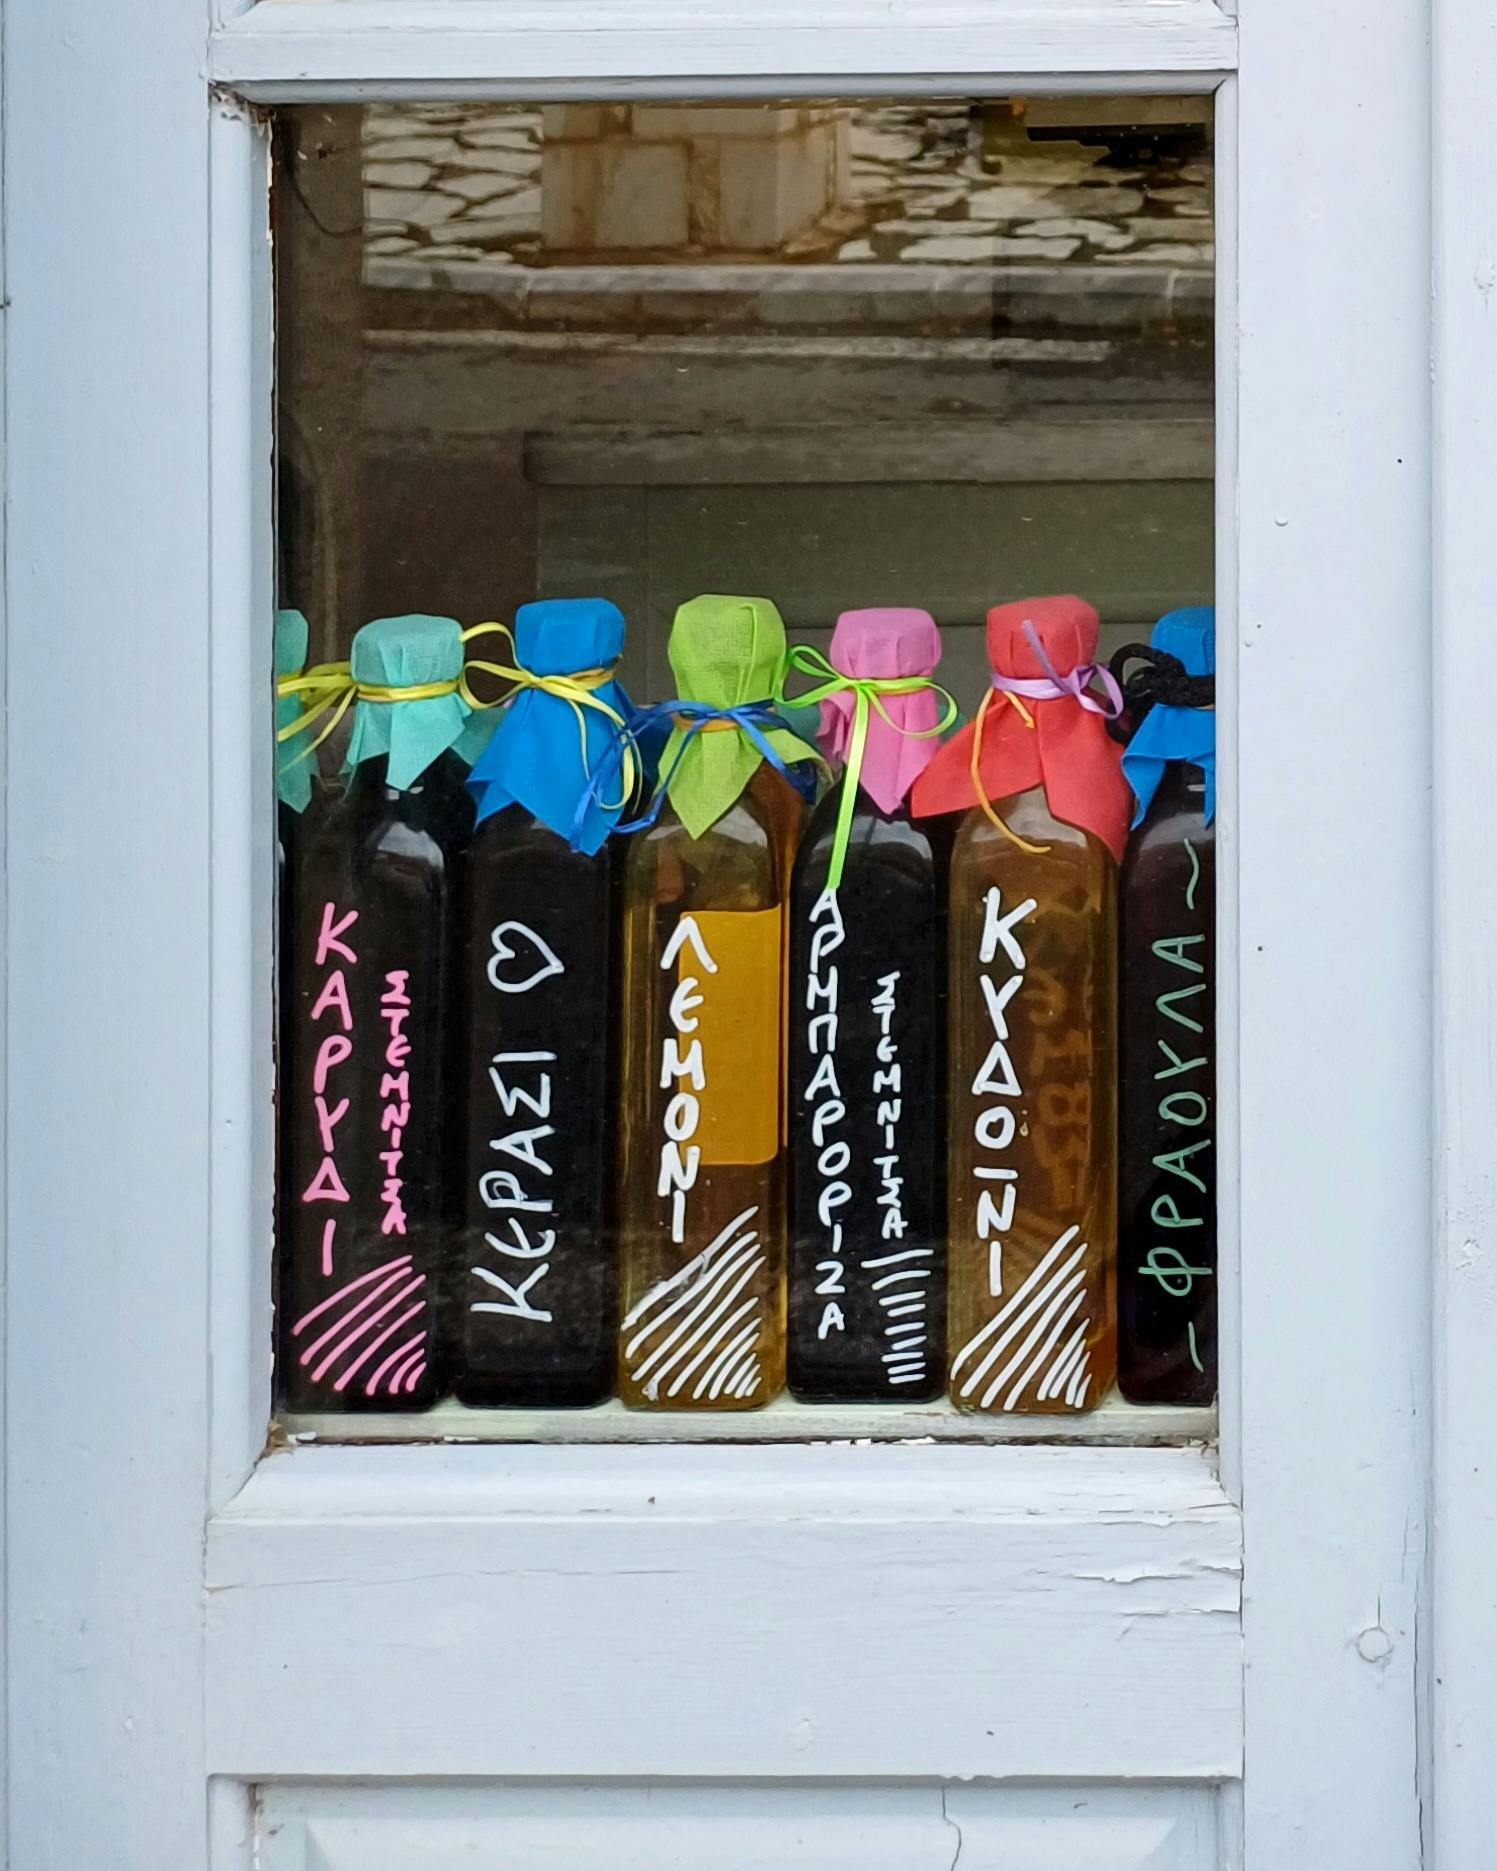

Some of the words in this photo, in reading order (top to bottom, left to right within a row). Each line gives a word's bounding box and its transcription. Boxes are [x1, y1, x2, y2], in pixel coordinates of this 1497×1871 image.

[302, 901, 359, 1277] ΚΑΡΥΔΙ
[469, 1049, 558, 1323] ΚΕΡΑΣΙ
[658, 914, 718, 1243] ΛΕΜΟΝΙ
[1137, 933, 1214, 1297] ΦΡΑΟΥΛΑ
